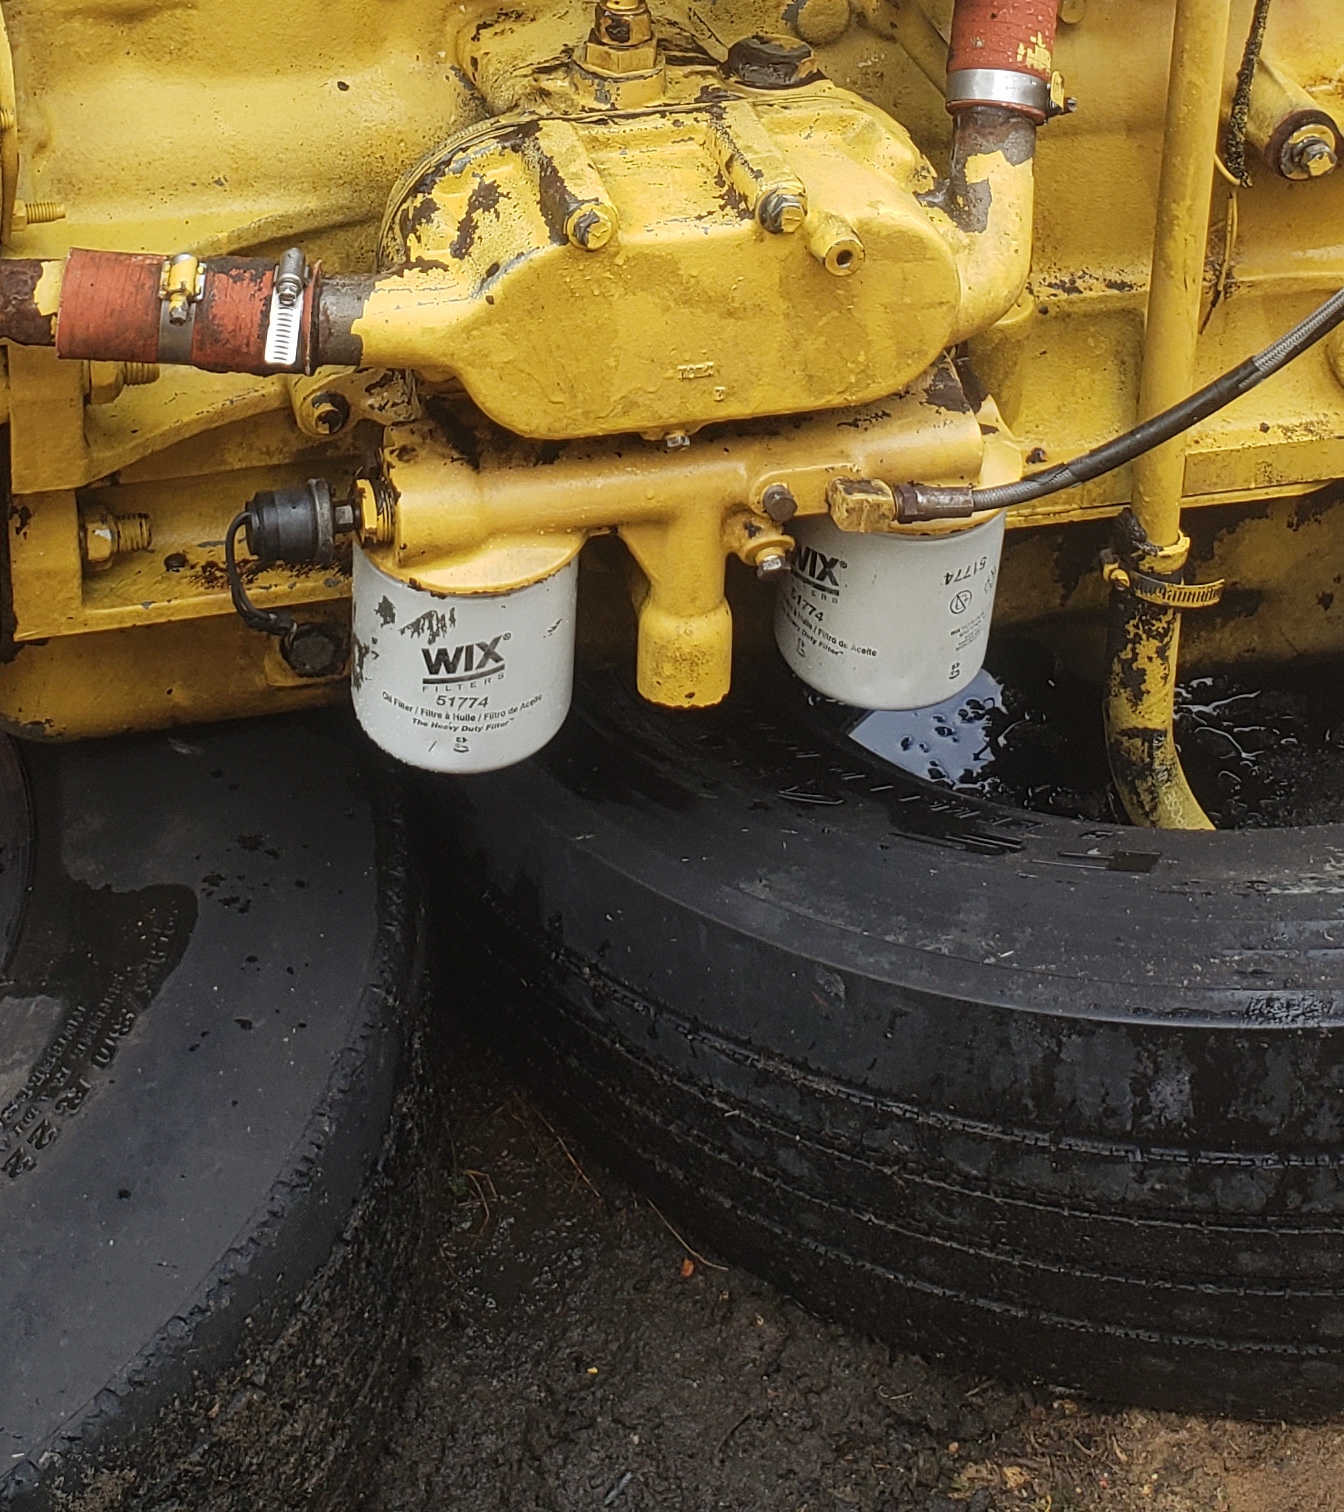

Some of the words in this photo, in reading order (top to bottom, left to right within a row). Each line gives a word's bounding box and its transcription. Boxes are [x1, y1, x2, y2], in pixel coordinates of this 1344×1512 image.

[944, 556, 987, 586] 51774
[421, 635, 504, 676] WIX
[817, 627, 837, 644] Filtro
[850, 642, 878, 658] Aceite
[422, 673, 505, 693] FILTERS
[382, 691, 393, 704] Oil
[393, 698, 413, 713] Filter
[420, 708, 442, 719] Filtre
[453, 712, 476, 722] Huile
[483, 709, 506, 720] Filtro
[508, 705, 519, 715] de
[520, 694, 543, 711] Aceite
[436, 695, 489, 710] 51774
[412, 717, 429, 727] The
[431, 721, 459, 733] Heavy
[461, 724, 484, 733] Duty
